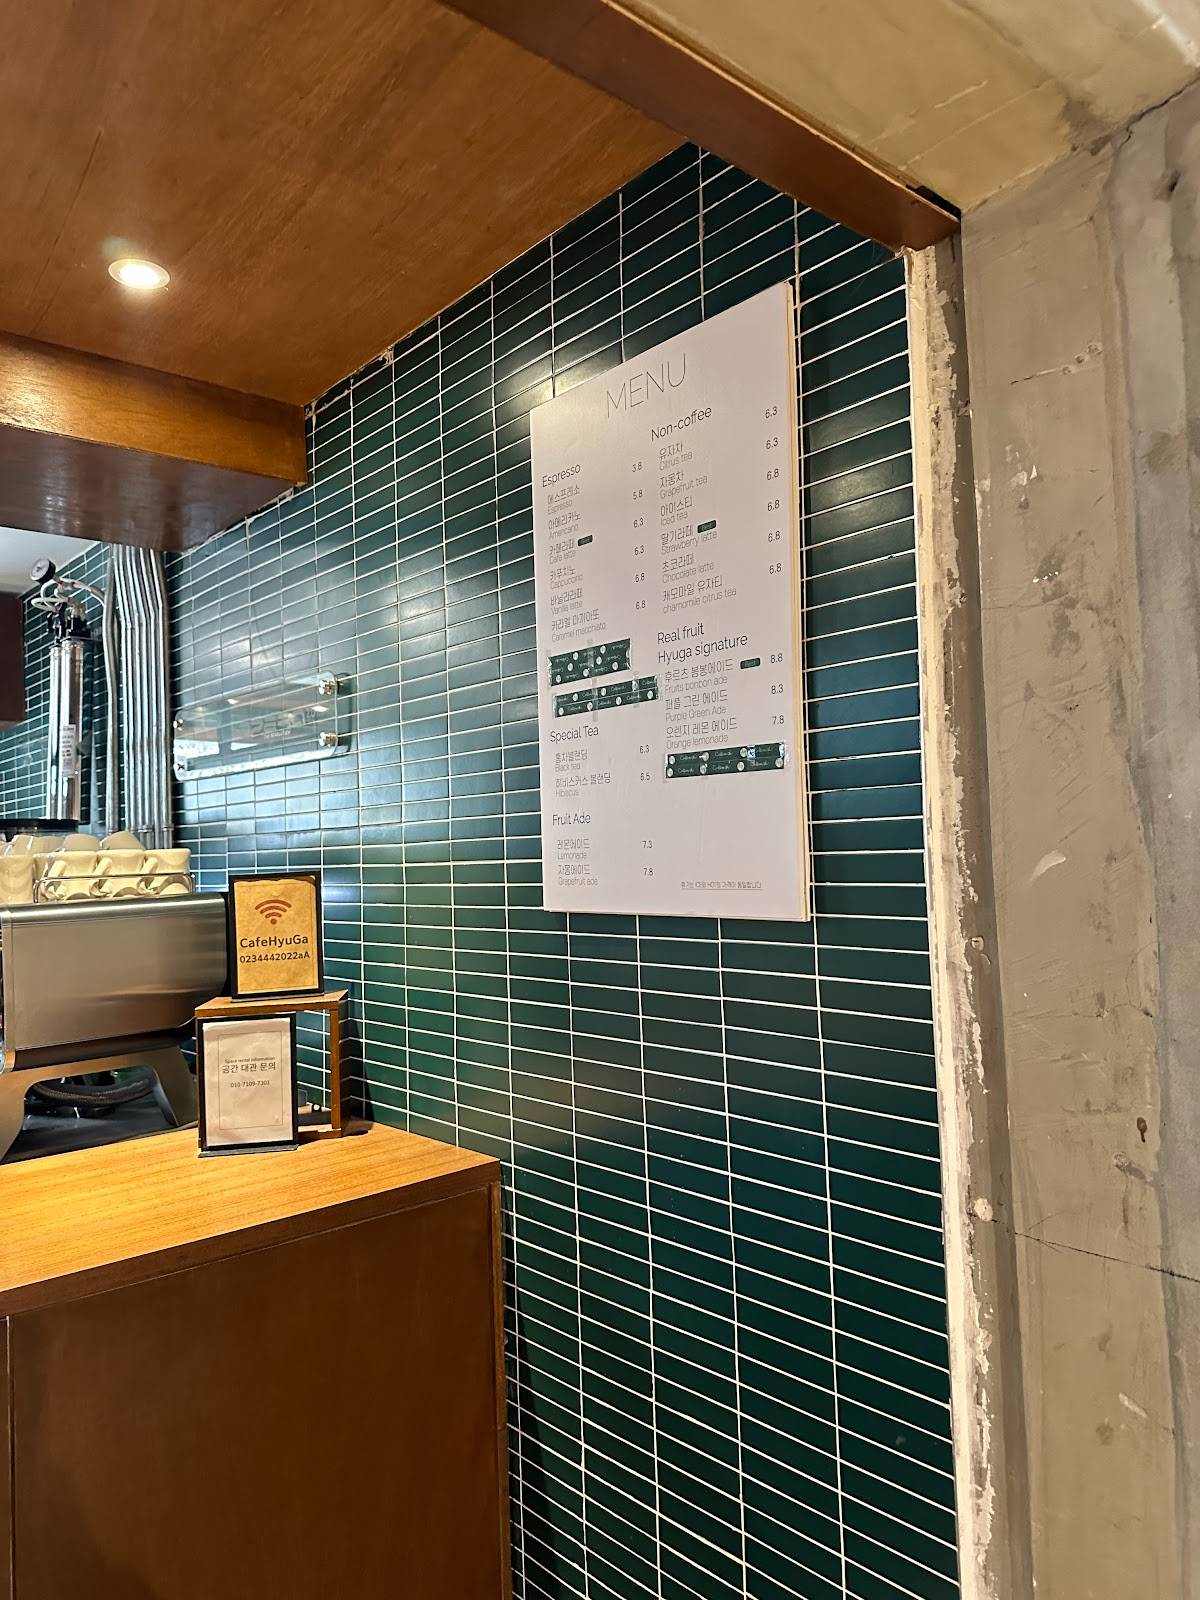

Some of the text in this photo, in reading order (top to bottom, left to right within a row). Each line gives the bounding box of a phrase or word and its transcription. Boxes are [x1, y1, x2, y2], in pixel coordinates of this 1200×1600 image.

[607, 352, 686, 418] MENU
[765, 406, 778, 419] 6.3
[651, 407, 712, 441] Non-coffee
[659, 440, 683, 460] 유자차
[766, 437, 779, 450] 6.3
[680, 451, 693, 461] tea
[632, 462, 642, 473] 3.8
[542, 464, 581, 487] Espresso
[660, 471, 684, 488] 자몽차
[767, 468, 780, 481] 6.8
[660, 475, 708, 499] Grapefruit tea
[660, 496, 693, 516] 아이스티
[767, 499, 780, 511] 6.8
[633, 517, 644, 528] 6.3
[676, 511, 688, 521] tea
[768, 531, 781, 543] 6.8
[634, 545, 645, 556] 6.3
[769, 563, 782, 574] 6.8
[697, 575, 723, 592] 유자티
[702, 590, 723, 604] citrus
[724, 587, 737, 598] tea
[635, 600, 646, 610] 6.8
[657, 622, 705, 645] Real fruit
[658, 635, 748, 665] Hyuga signature
[770, 653, 783, 664] 8.8
[713, 675, 728, 685] ade
[771, 684, 784, 695] 8.3
[702, 689, 728, 705] 에이드
[665, 706, 727, 723] Purple Green Ade
[772, 715, 785, 725] 7.8
[692, 721, 709, 735] 레몬
[711, 717, 738, 732] 에이드
[550, 725, 599, 744] Special Tea
[666, 733, 729, 750] Orange lemonade
[639, 744, 650, 754] 6.3
[552, 812, 592, 826] Fruit Ade
[642, 840, 653, 849] 7.3
[643, 868, 654, 877] 7.8
[240, 934, 309, 948] CafeHyuGa
[239, 951, 310, 963] 0234442022aA
[222, 1062, 276, 1074] 공간 대관 문의
